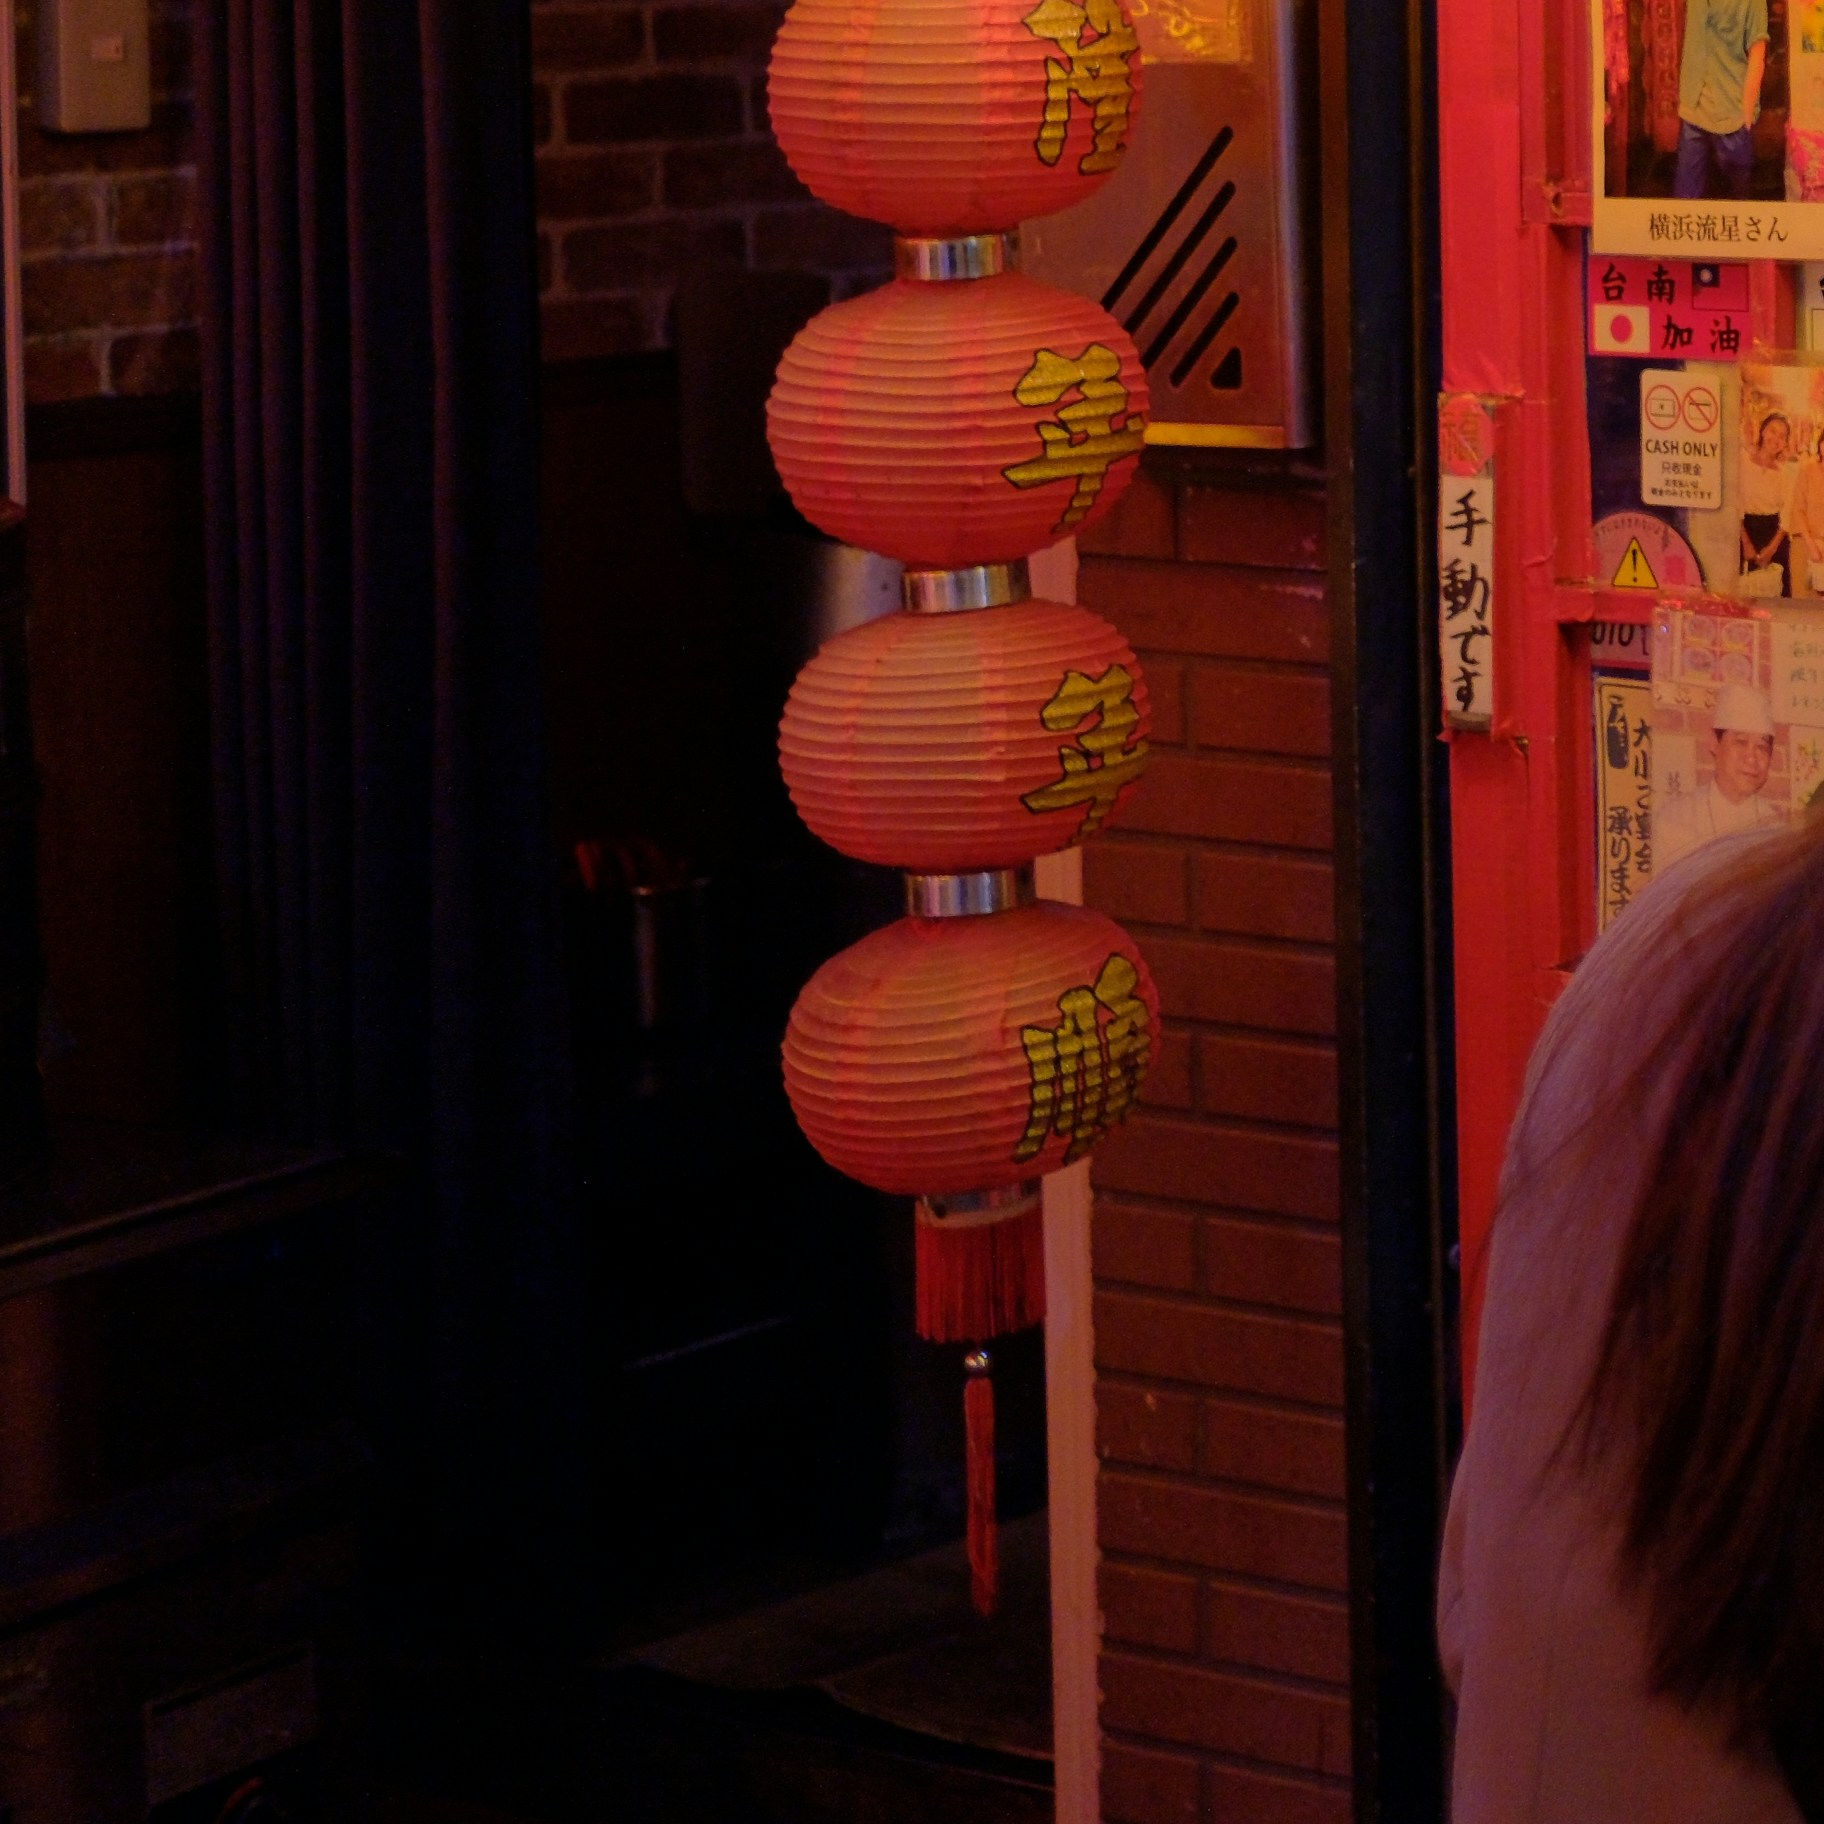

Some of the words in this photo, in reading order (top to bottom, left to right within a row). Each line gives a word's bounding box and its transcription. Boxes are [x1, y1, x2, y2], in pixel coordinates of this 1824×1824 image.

[1647, 214, 1790, 245] 横浜流星さん
[1600, 264, 1676, 306] 台南
[1661, 314, 1742, 354] 加油
[1644, 438, 1680, 456] CASH
[1682, 440, 1720, 458] ONLY
[1444, 487, 1492, 713] 手動です
